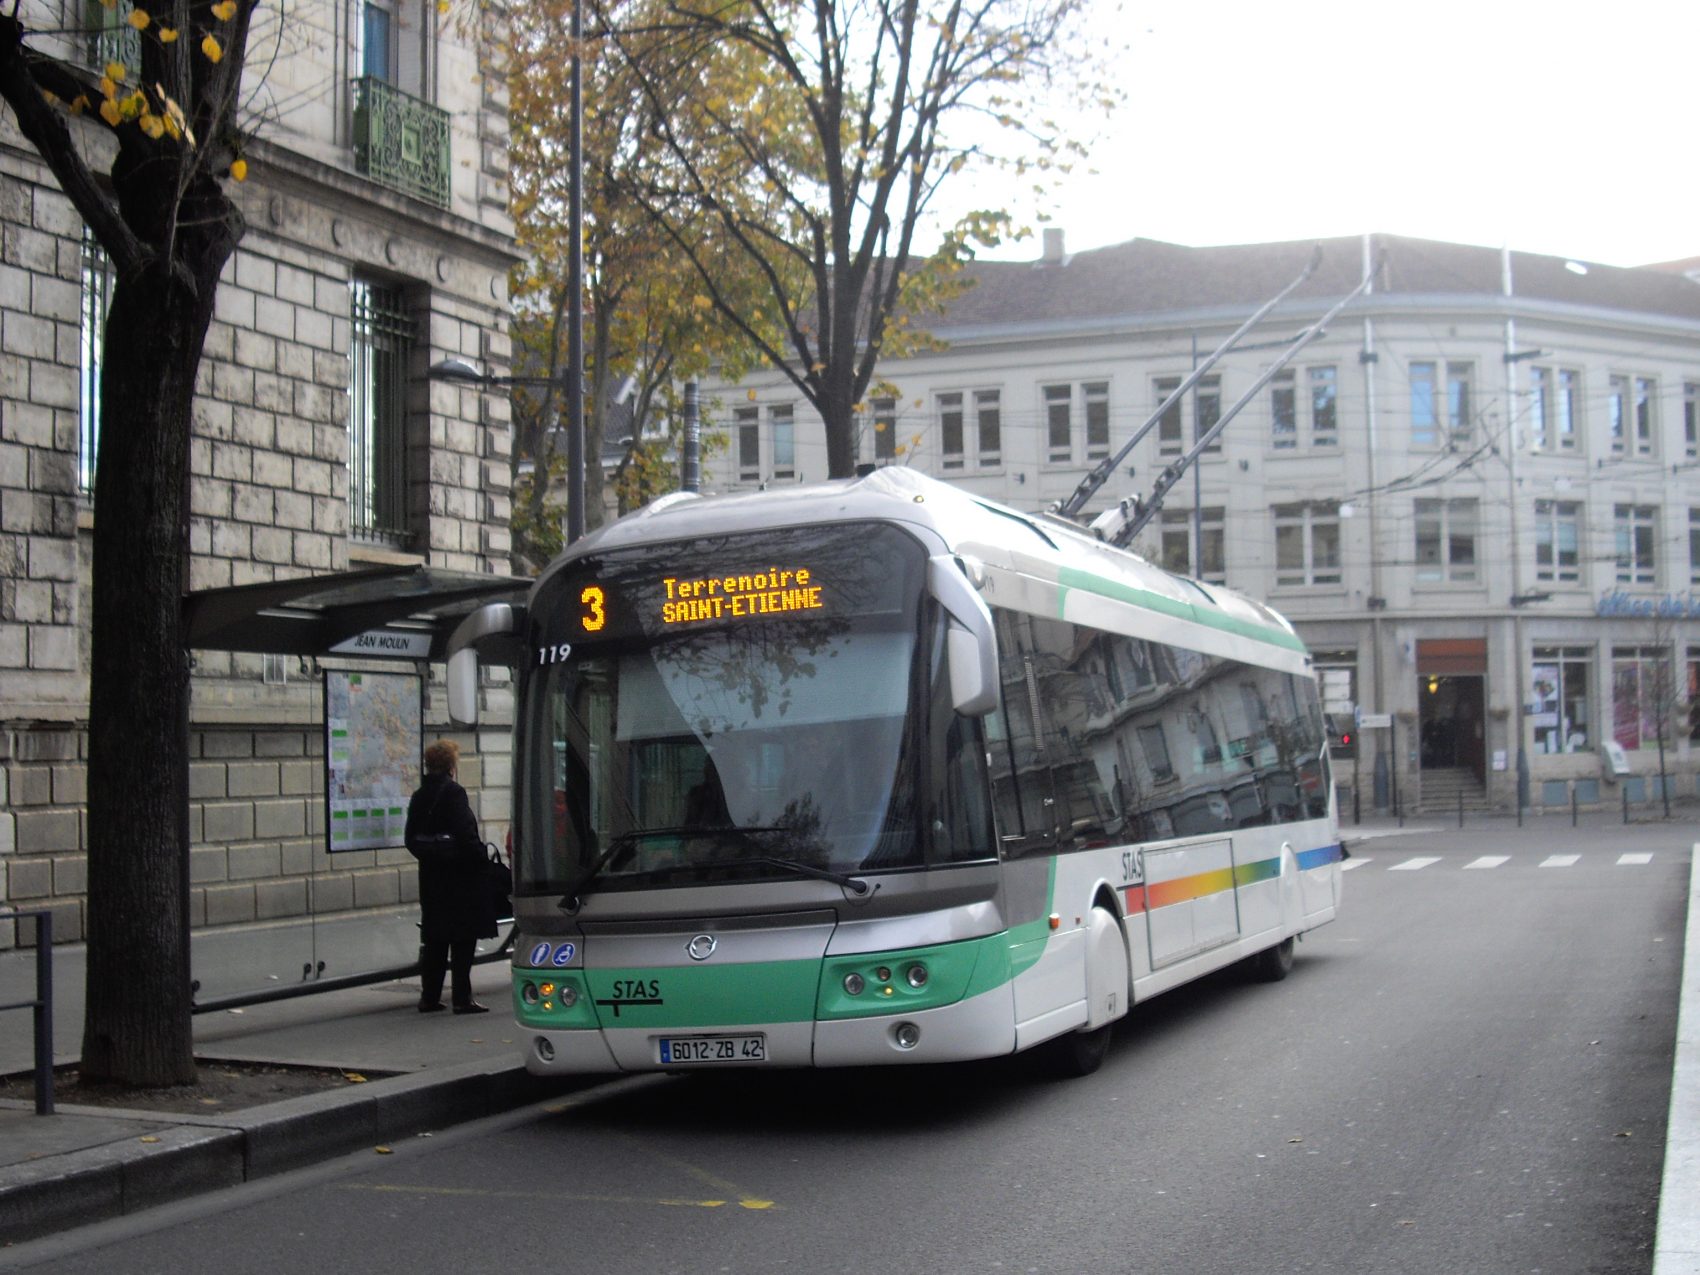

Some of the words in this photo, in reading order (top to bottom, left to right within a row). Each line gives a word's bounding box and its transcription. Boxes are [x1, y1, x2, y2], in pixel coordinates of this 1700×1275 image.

[663, 568, 810, 599] Terrenoire
[581, 587, 605, 632] 3
[662, 587, 823, 623] SAINT-ETIENNE
[354, 635, 376, 648] JEAN
[377, 636, 410, 650] MOULIN
[539, 644, 572, 665] 119
[1121, 850, 1144, 881] STAS
[612, 980, 660, 999] STAS
[741, 1039, 761, 1058] 42
